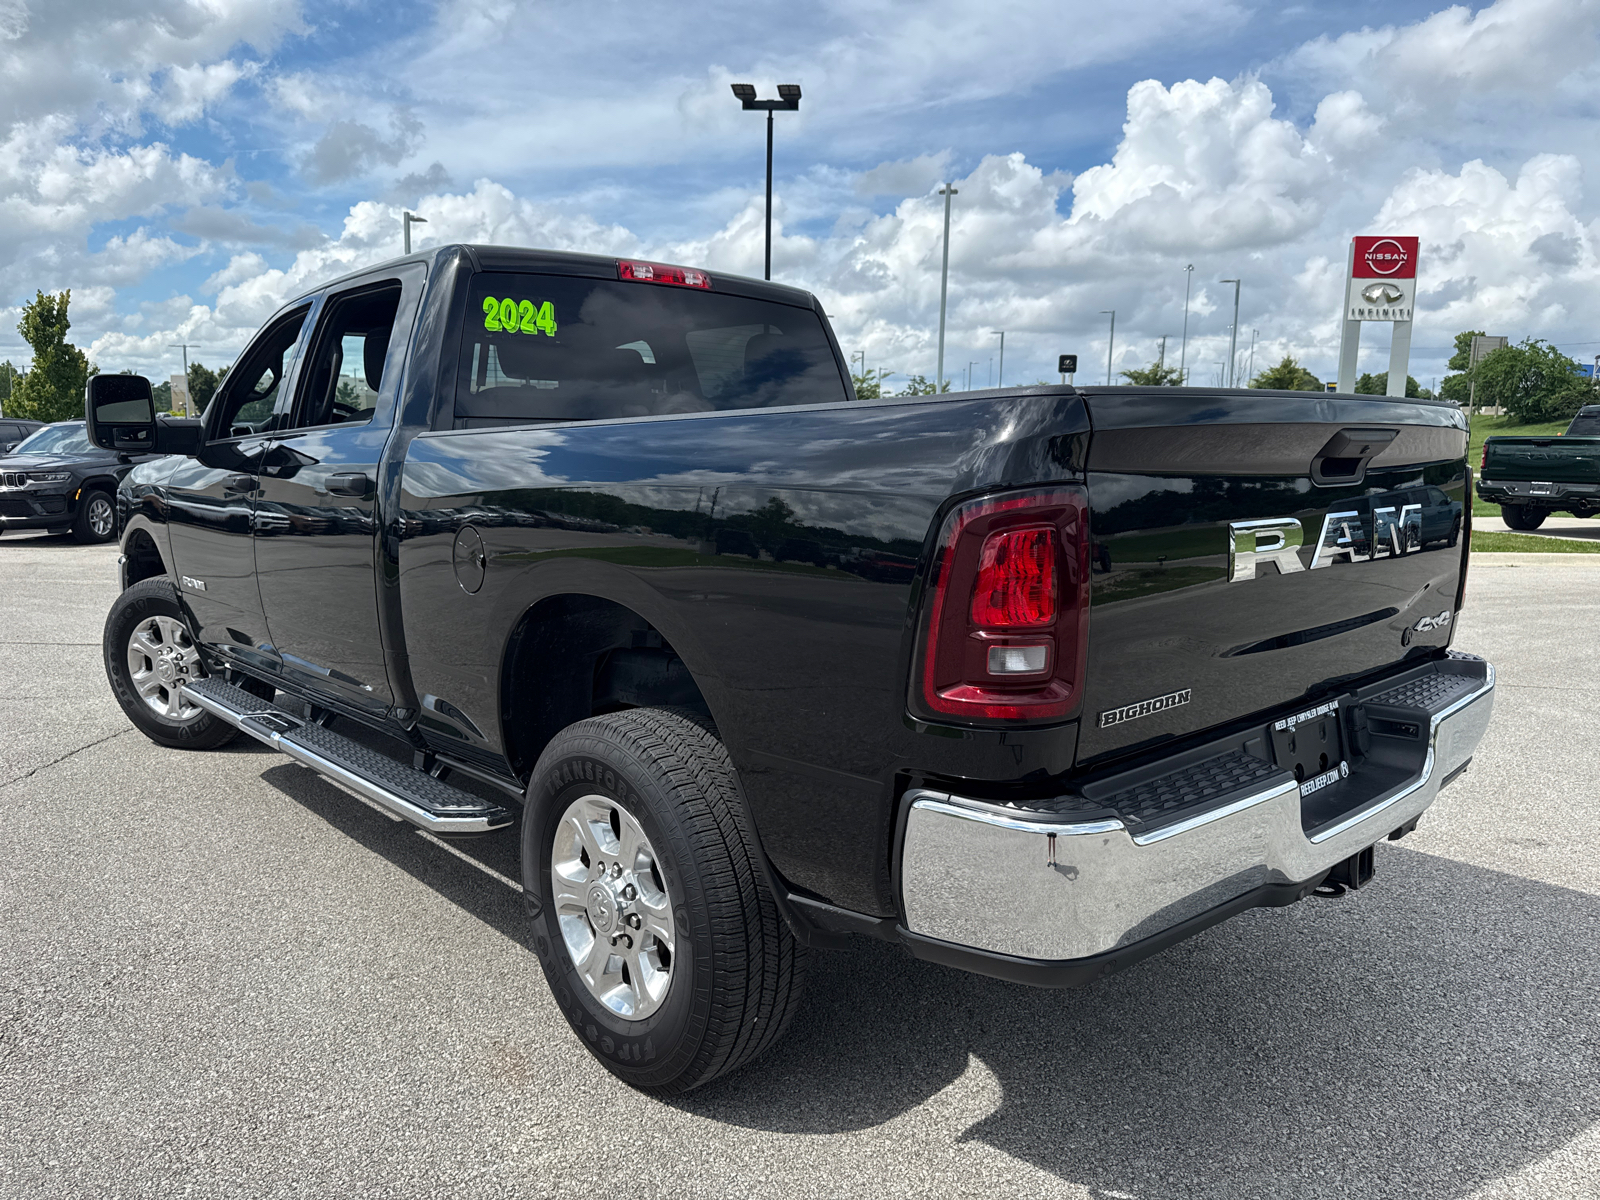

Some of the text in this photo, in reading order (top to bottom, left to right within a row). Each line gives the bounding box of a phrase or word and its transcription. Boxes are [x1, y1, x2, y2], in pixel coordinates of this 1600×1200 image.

[482, 296, 558, 337] 2024
[1351, 308, 1410, 317] INFINITI
[1227, 503, 1422, 583] RAM
[182, 575, 207, 592] RAM
[1274, 700, 1340, 731] REED JEEP CHRYSLER DODGE RAM
[544, 760, 650, 824] TRANSFORCE
[1300, 769, 1340, 797] REEDJEEP.COM
